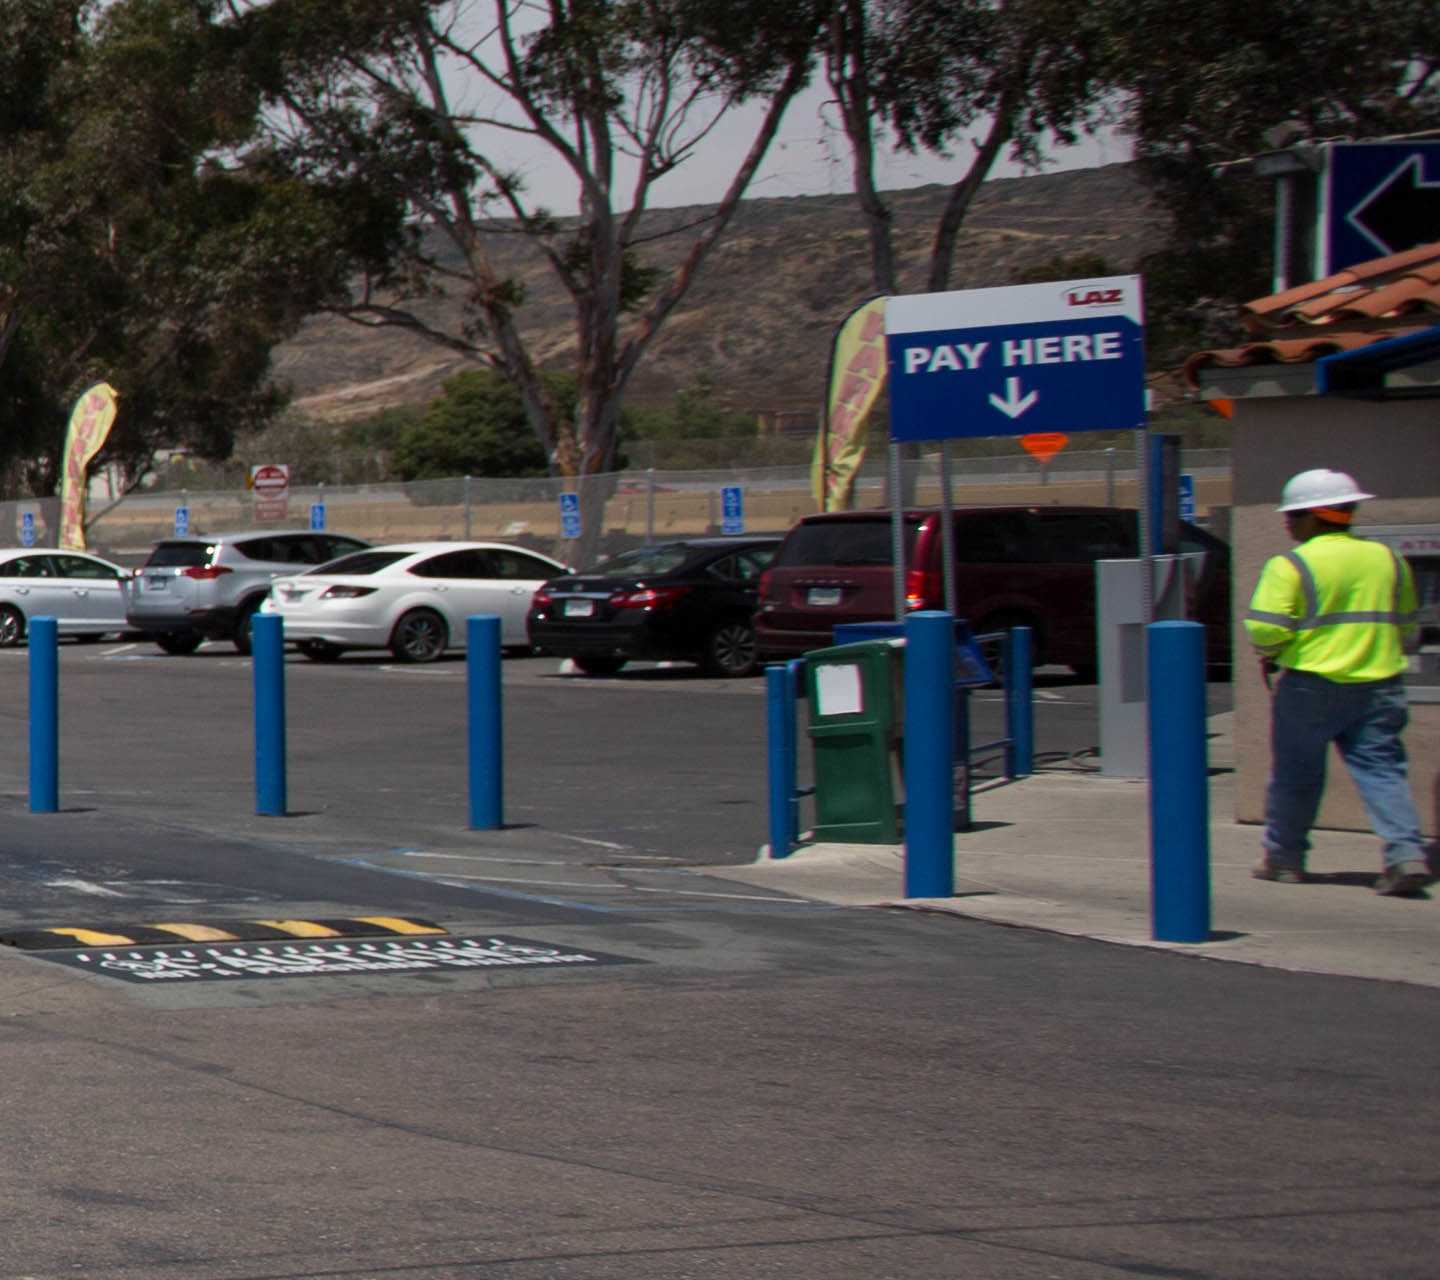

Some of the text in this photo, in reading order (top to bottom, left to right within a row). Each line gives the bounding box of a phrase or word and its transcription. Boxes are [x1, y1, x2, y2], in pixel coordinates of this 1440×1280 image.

[1068, 289, 1124, 306] LAZ
[903, 331, 1124, 375] PAY HERE
[154, 947, 499, 970] CAUTION
[131, 969, 200, 979] NOT
